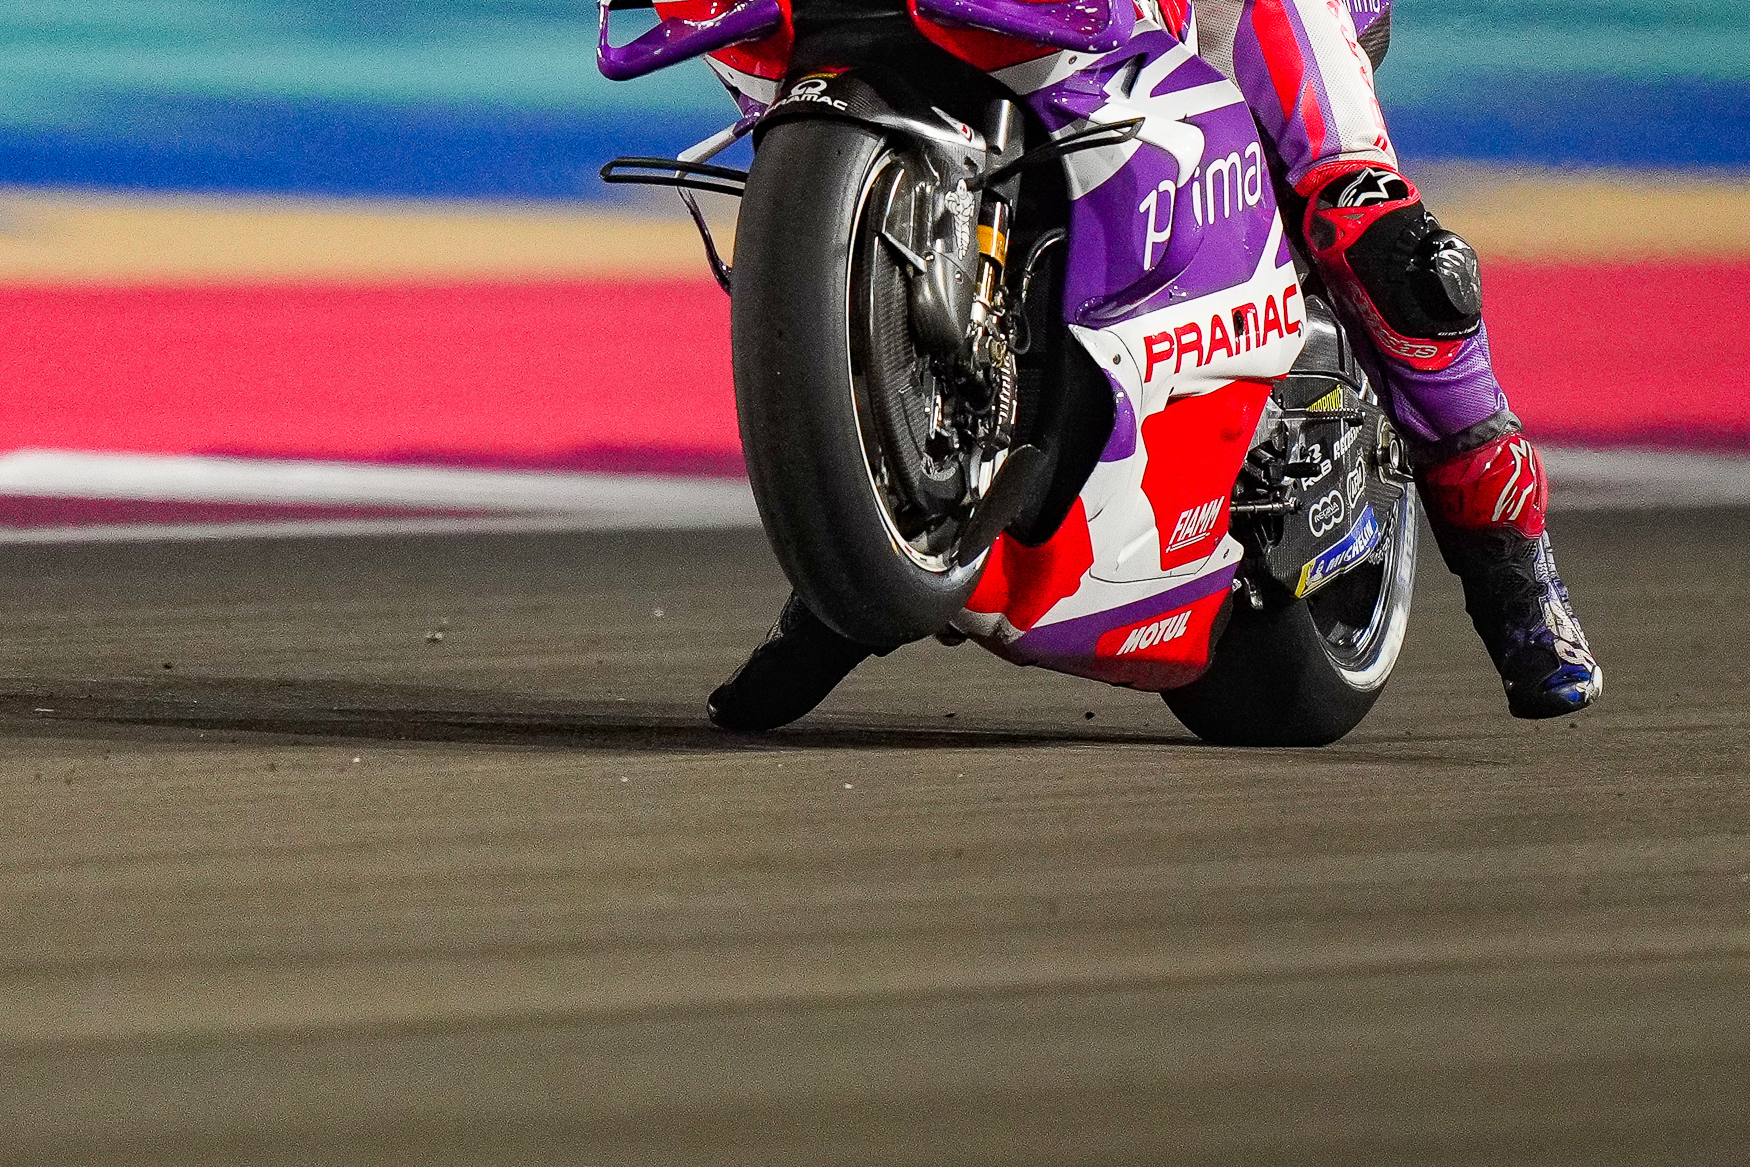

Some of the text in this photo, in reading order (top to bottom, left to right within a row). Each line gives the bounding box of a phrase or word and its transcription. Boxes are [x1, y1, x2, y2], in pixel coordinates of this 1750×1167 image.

[1138, 140, 1263, 272] pima
[1143, 283, 1303, 384] PRAMAC
[1168, 495, 1227, 548] FIAMM
[1325, 519, 1375, 574] MICHELIN
[1116, 609, 1193, 656] MOTUL
